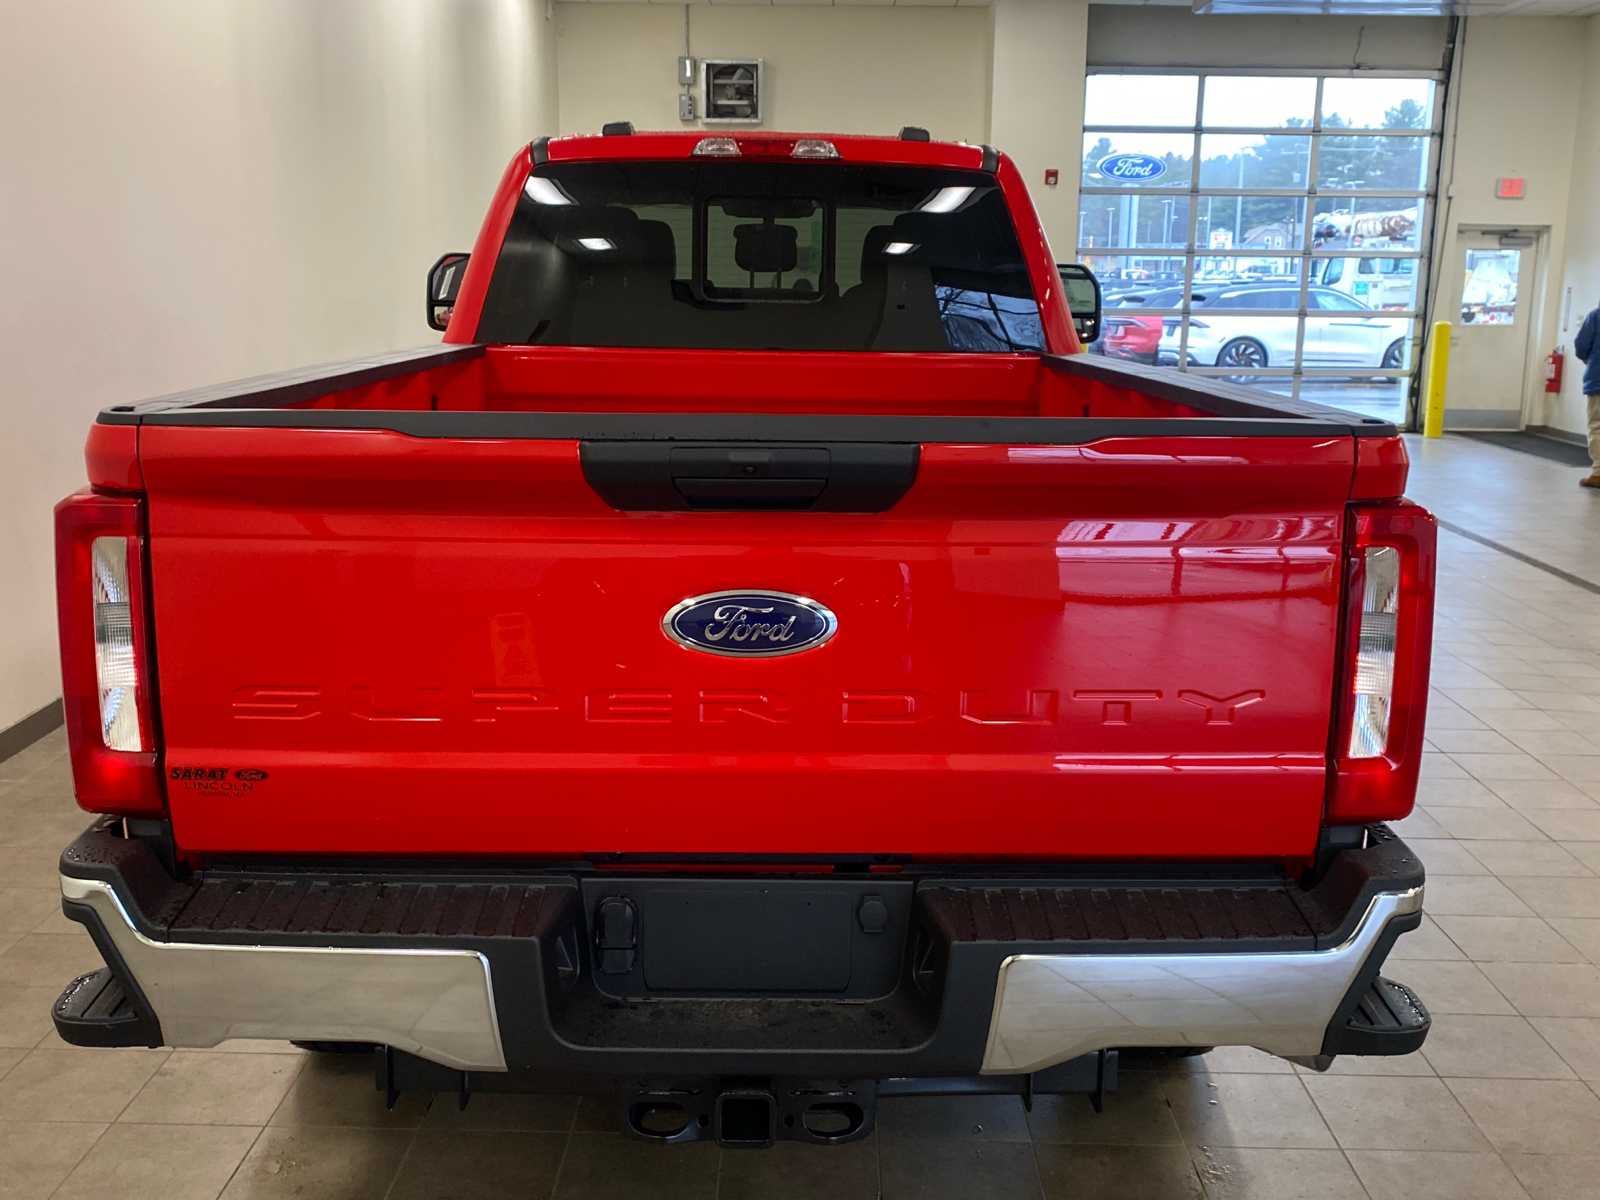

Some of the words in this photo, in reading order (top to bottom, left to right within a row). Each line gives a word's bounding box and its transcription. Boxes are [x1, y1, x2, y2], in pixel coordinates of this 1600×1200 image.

[1113, 158, 1154, 176] Ford
[704, 604, 797, 642] Ford
[231, 685, 790, 725] SUPER
[842, 689, 1267, 726] DUTY
[171, 767, 228, 780] SARAT
[185, 781, 254, 790] LINCOLN
